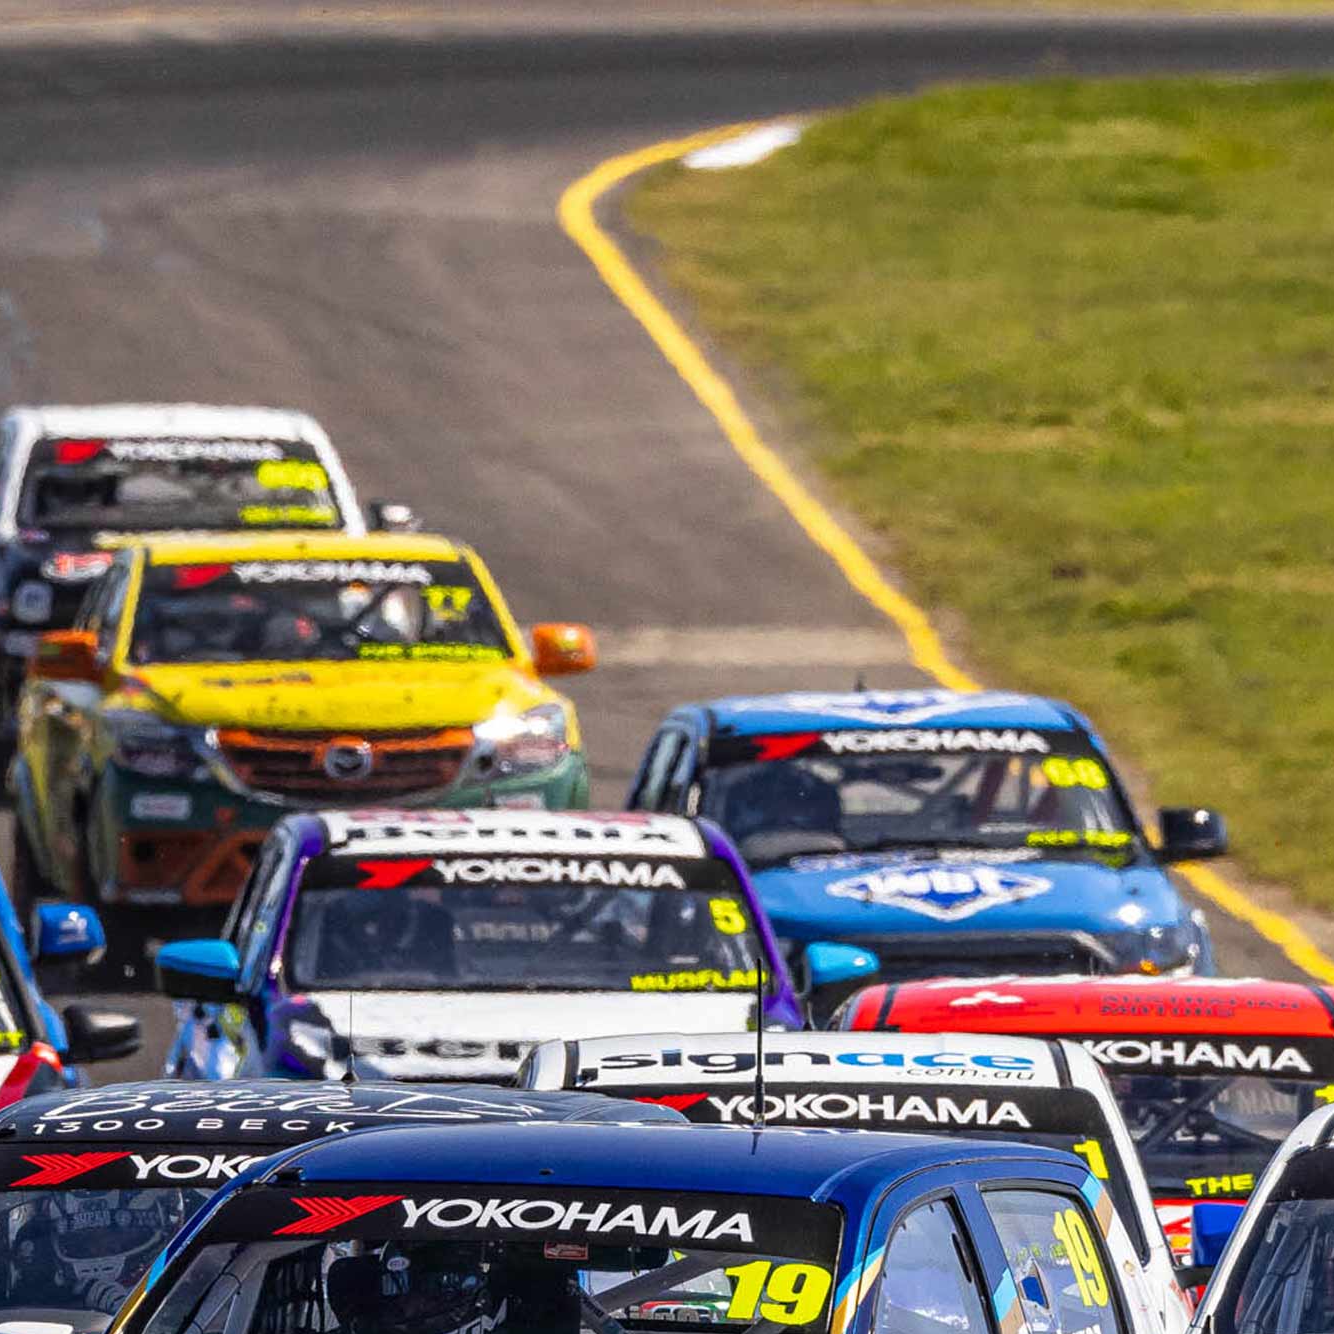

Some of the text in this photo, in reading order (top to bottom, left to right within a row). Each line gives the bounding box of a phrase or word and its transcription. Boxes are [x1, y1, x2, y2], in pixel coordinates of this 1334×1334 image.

[435, 859, 685, 888] YOKOHAMA
[709, 900, 745, 934] 5
[600, 1049, 1035, 1075] signace
[1089, 1039, 1312, 1074] KOHAMA
[33, 1118, 355, 1136] 1300 BECK
[708, 1094, 1032, 1129] YOKOHAMA
[1185, 1172, 1255, 1196] THE
[401, 1198, 754, 1243] YOKOHAMA
[1052, 1207, 1109, 1309] 19
[725, 1261, 832, 1325] 19
